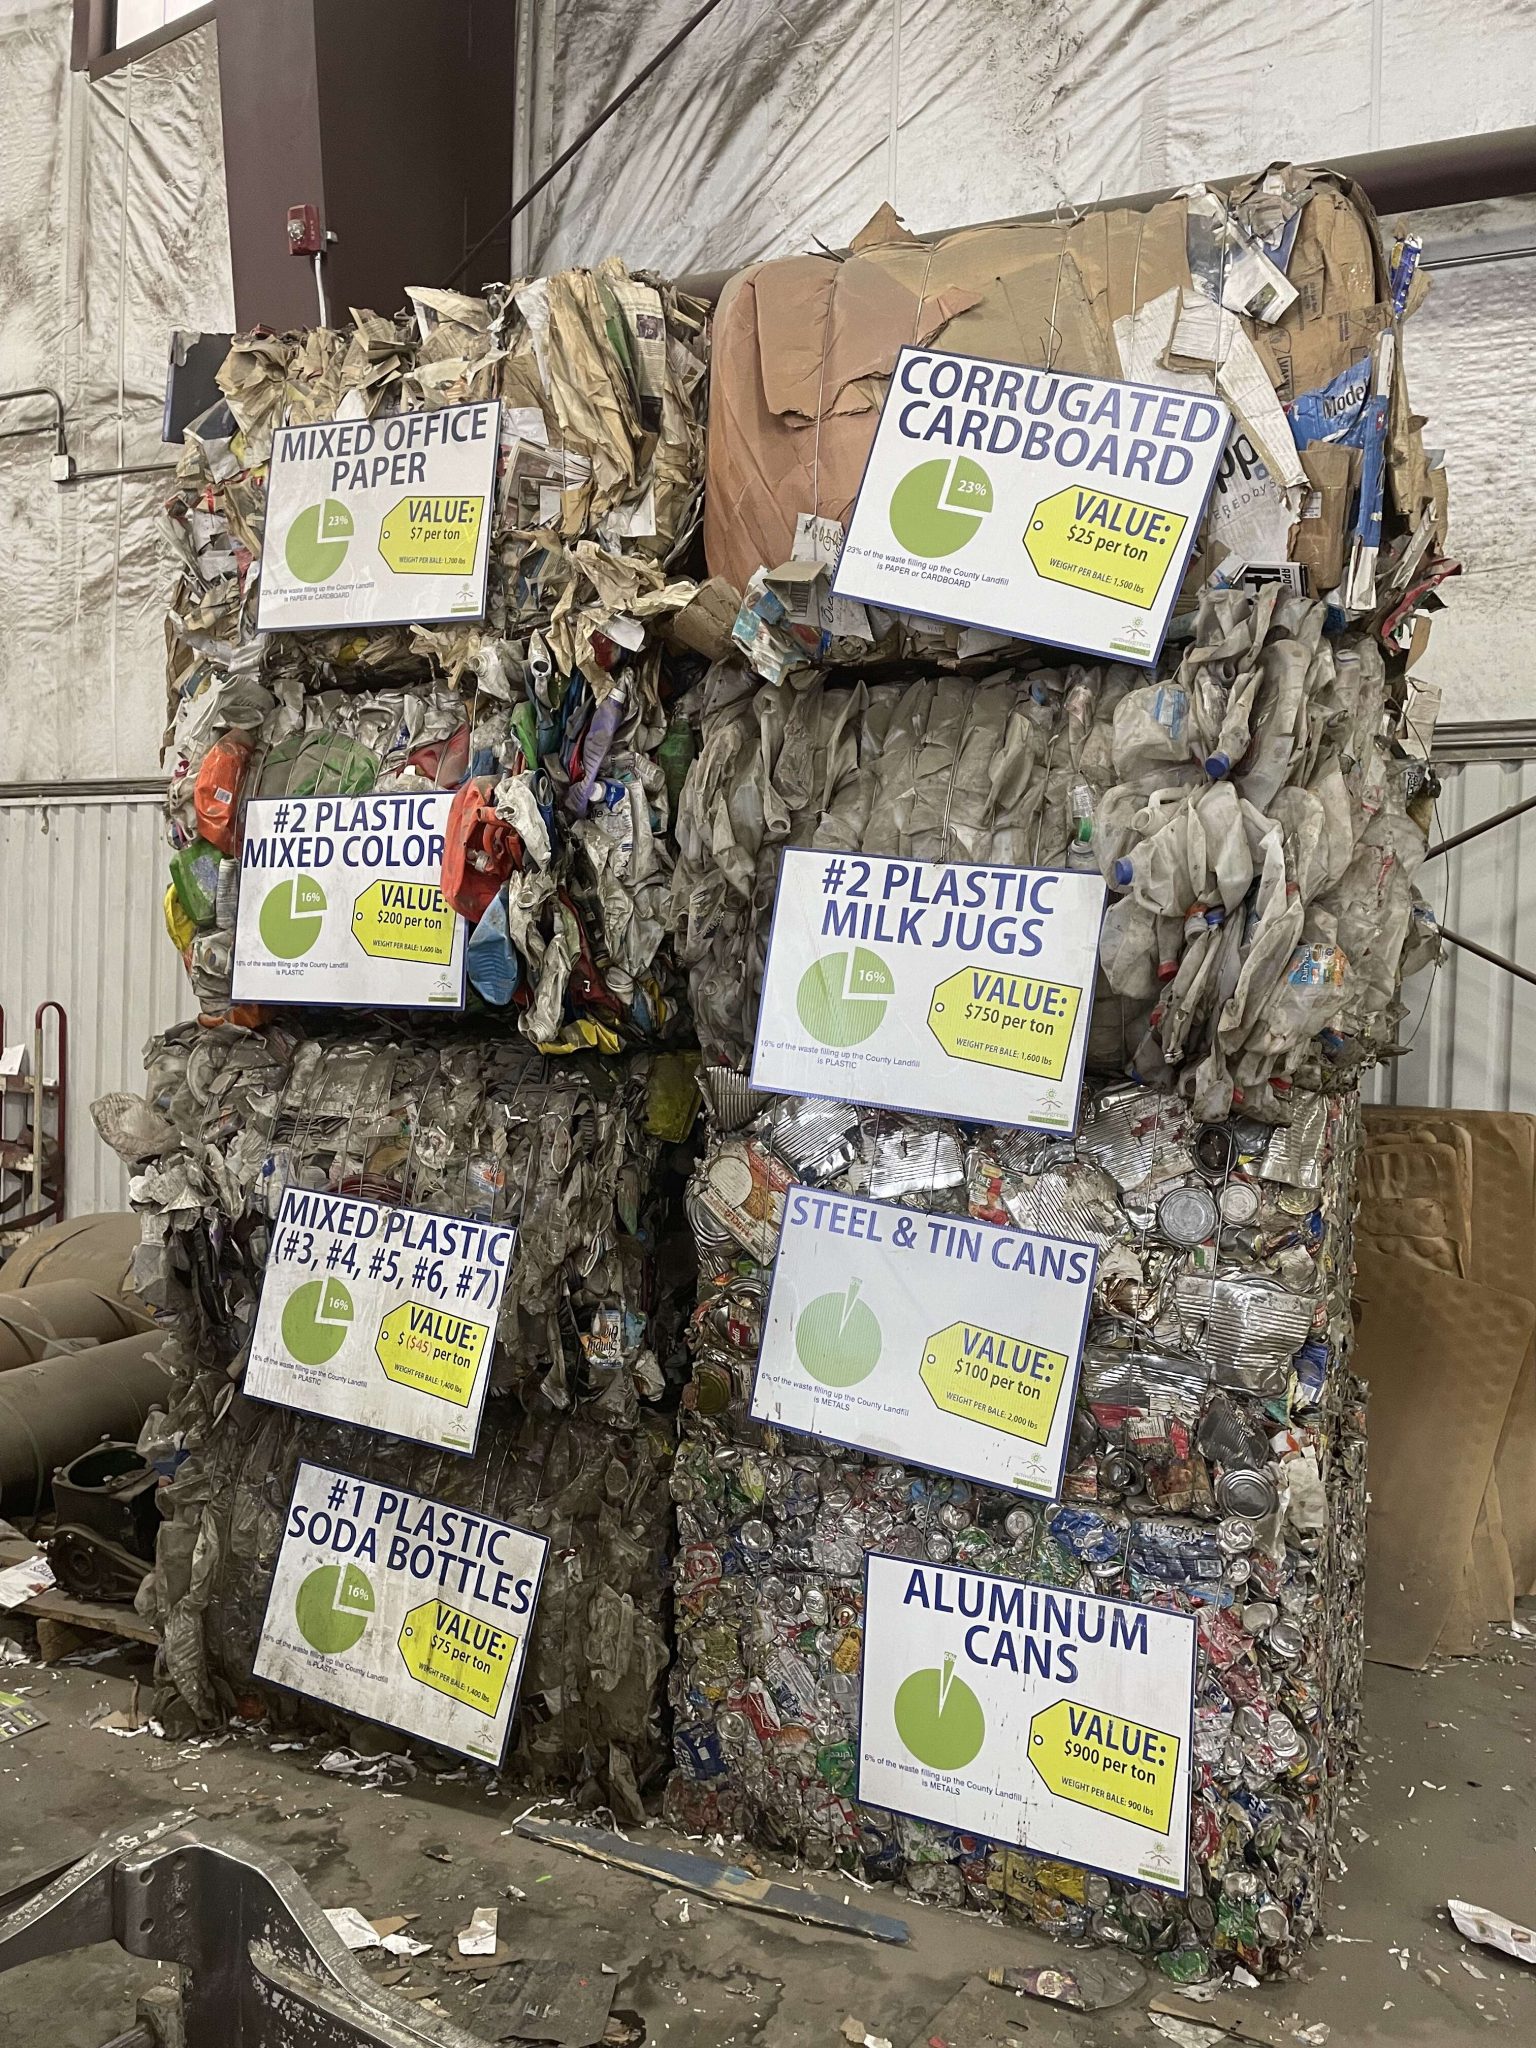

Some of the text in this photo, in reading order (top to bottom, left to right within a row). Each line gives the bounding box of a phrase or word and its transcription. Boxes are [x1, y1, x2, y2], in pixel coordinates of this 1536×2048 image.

[900, 356, 1220, 442] CORRUGATED
[280, 407, 488, 463] MIXED OFFICE
[898, 400, 1193, 485] CARDBOARD
[331, 451, 426, 492] PAPER
[957, 479, 986, 496] 23%
[328, 515, 348, 526] 23%
[409, 500, 475, 523] VALUE:
[1075, 491, 1171, 545] VALUE:
[410, 526, 460, 543] $7 per ton
[1066, 524, 1148, 562] $25 per ton
[1049, 557, 1144, 593] WEIGHT PER BALE: 1,500 lbs
[273, 797, 436, 833] #2 PLASTIC
[243, 836, 334, 868] MIXED
[301, 892, 320, 902] 16%
[822, 859, 1059, 914] #2 PLASTIC
[377, 909, 441, 929] $200 per ton
[821, 899, 1044, 957] MILK JUGS
[859, 969, 885, 983] 16%
[973, 972, 1067, 1017] VALUE:
[964, 1003, 1054, 1036] $750 per ton
[956, 1037, 1052, 1066] WEIGHT PER BALE: 1,600 lbs
[280, 1192, 510, 1266] MIXED PLASTIC
[790, 1196, 882, 1242] STEEL
[892, 1216, 917, 1249] &
[927, 1221, 982, 1262] TIN
[991, 1237, 1088, 1284] CANS
[274, 1227, 499, 1309] (#3, #4, #5, #6, #7)
[329, 1297, 348, 1311] 16%
[410, 1306, 477, 1351] VALUE:
[397, 1332, 405, 1346] $
[432, 1347, 452, 1361] per
[453, 1352, 470, 1369] ton
[964, 1328, 1054, 1383] VALUE:
[394, 1363, 462, 1393] WEIGHT PER BALE: 1,400 lbs
[954, 1358, 1040, 1400] $100 per ton
[946, 1391, 1038, 1430] WEIGHT PER BALE: 2,000 lbs
[327, 1478, 511, 1566] #1 PLASTIC
[287, 1505, 532, 1614] SODA BOTTLES
[348, 1584, 368, 1600] 16%
[903, 1568, 1147, 1655] ALUMINUM
[436, 1603, 510, 1660] VALUE:
[430, 1634, 490, 1674] $75 per ton
[964, 1624, 1078, 1684] CANS
[1069, 1706, 1166, 1766] VALUE:
[1064, 1739, 1155, 1785] $900 per ton
[1061, 1776, 1153, 1816] WEIGHT PER BALE: 900 lbs
